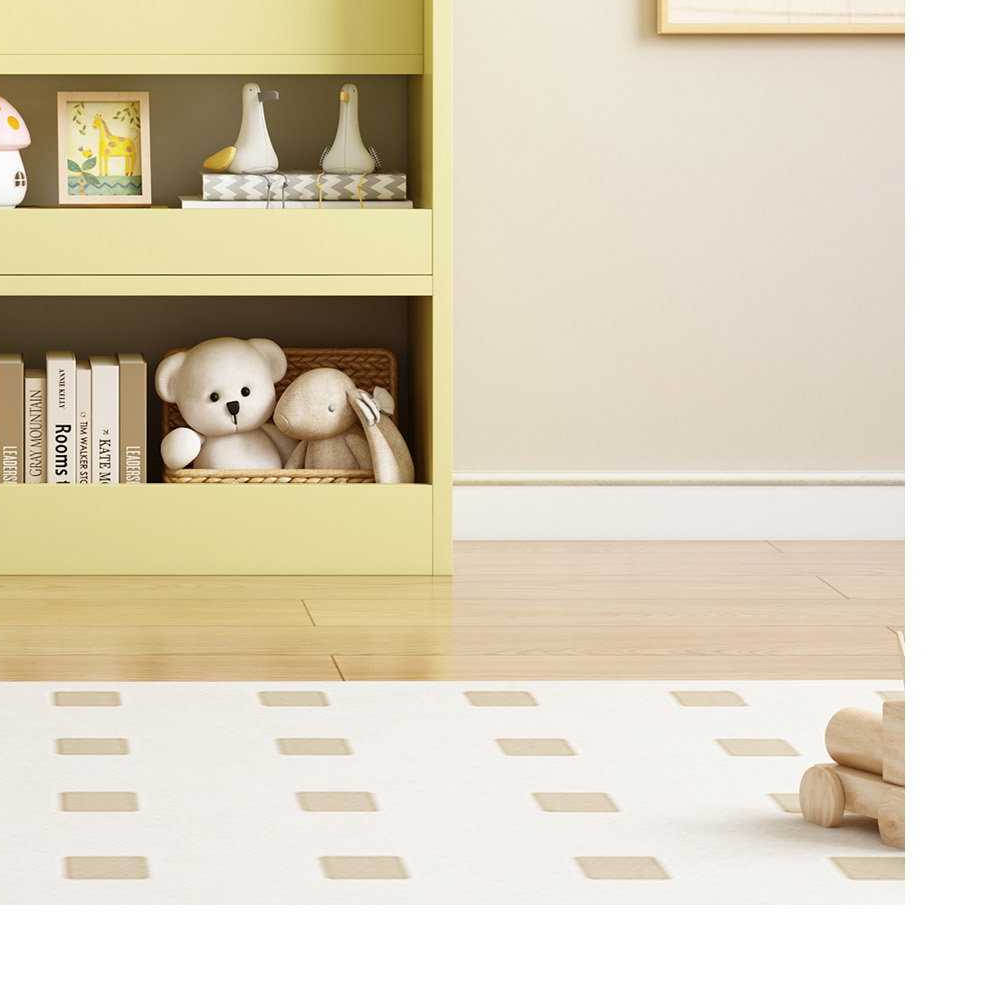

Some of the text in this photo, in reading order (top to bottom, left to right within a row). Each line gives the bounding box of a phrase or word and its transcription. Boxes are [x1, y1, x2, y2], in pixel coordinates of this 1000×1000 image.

[29, 390, 42, 477] GRAY MOUNTAIN
[79, 421, 88, 435] TIM
[55, 424, 71, 476] Rooms
[79, 437, 88, 469] WALKER
[99, 439, 111, 469] KATE
